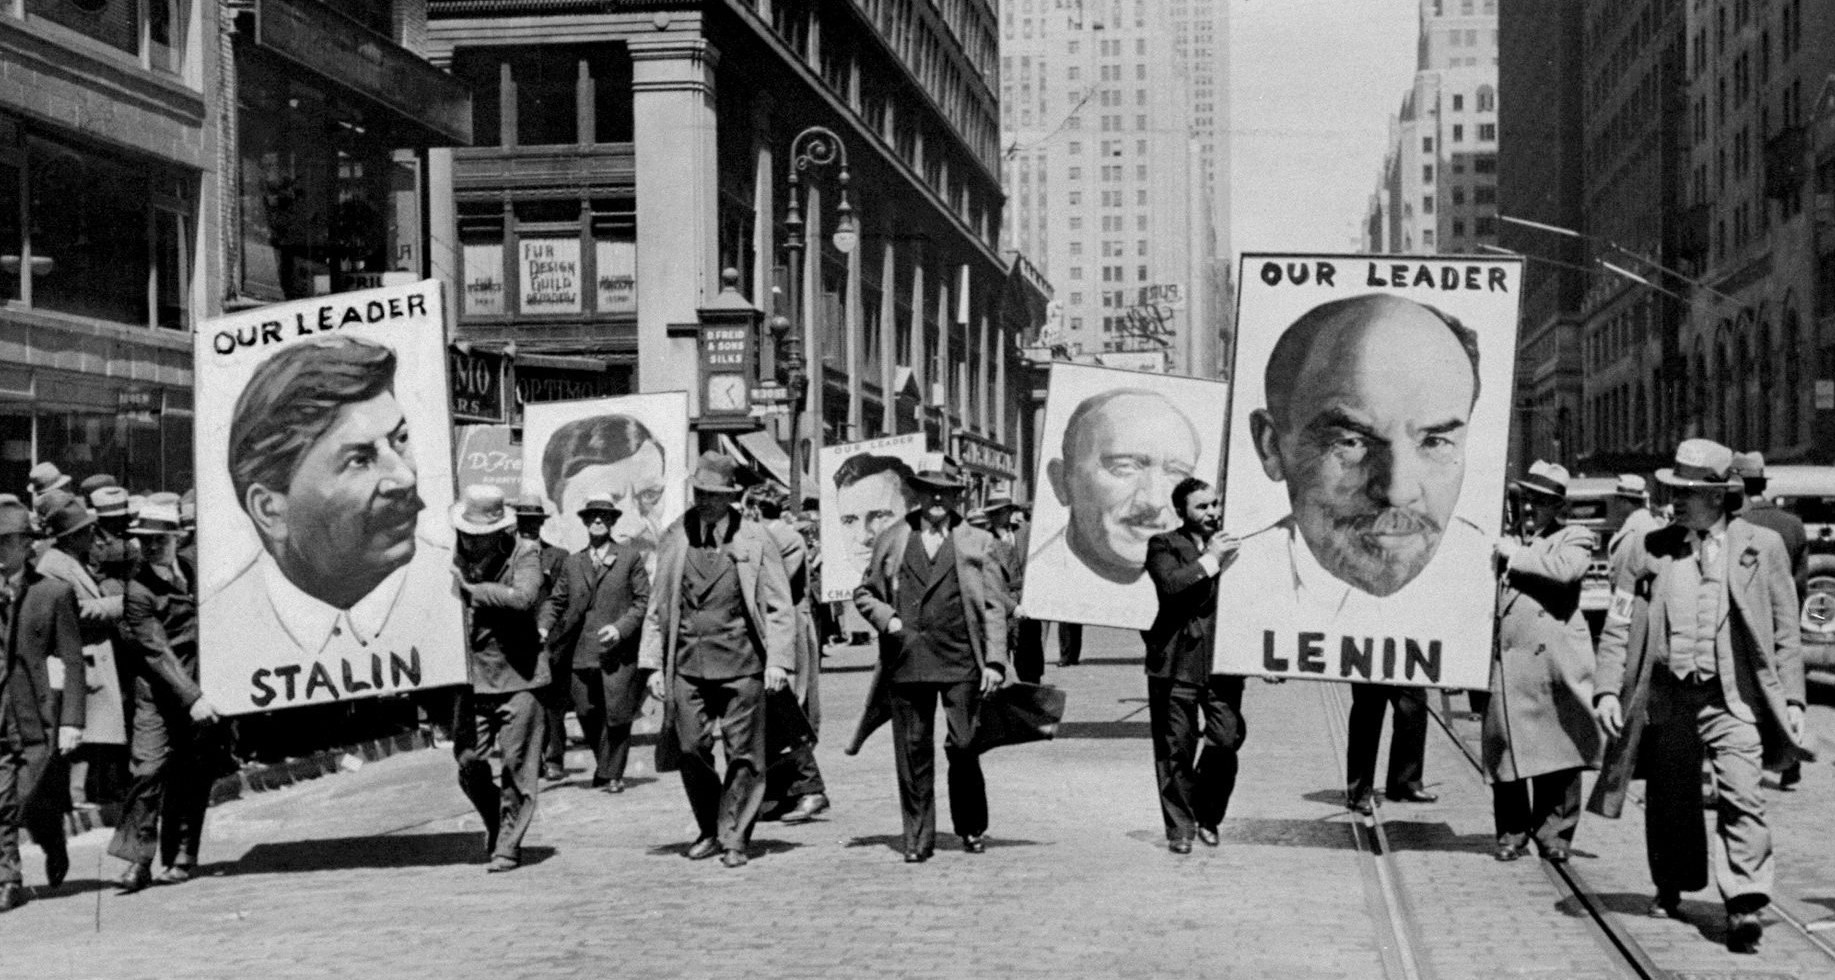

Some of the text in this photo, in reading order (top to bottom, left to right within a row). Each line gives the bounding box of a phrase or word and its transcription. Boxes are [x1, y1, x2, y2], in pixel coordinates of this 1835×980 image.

[524, 244, 554, 260] FUR
[530, 260, 576, 277] DESIGN
[1260, 261, 1509, 293] OUR LEADER
[531, 275, 572, 293] GUILD
[213, 294, 427, 355] OUR LEADER
[717, 341, 745, 351] SONS
[710, 353, 743, 364] SILKS
[452, 354, 490, 395] MO
[458, 398, 480, 414] RS
[834, 435, 914, 455] OUR LEADER
[828, 589, 852, 599] CHA
[1262, 629, 1442, 684] LENIN
[250, 645, 422, 708] STALIN
